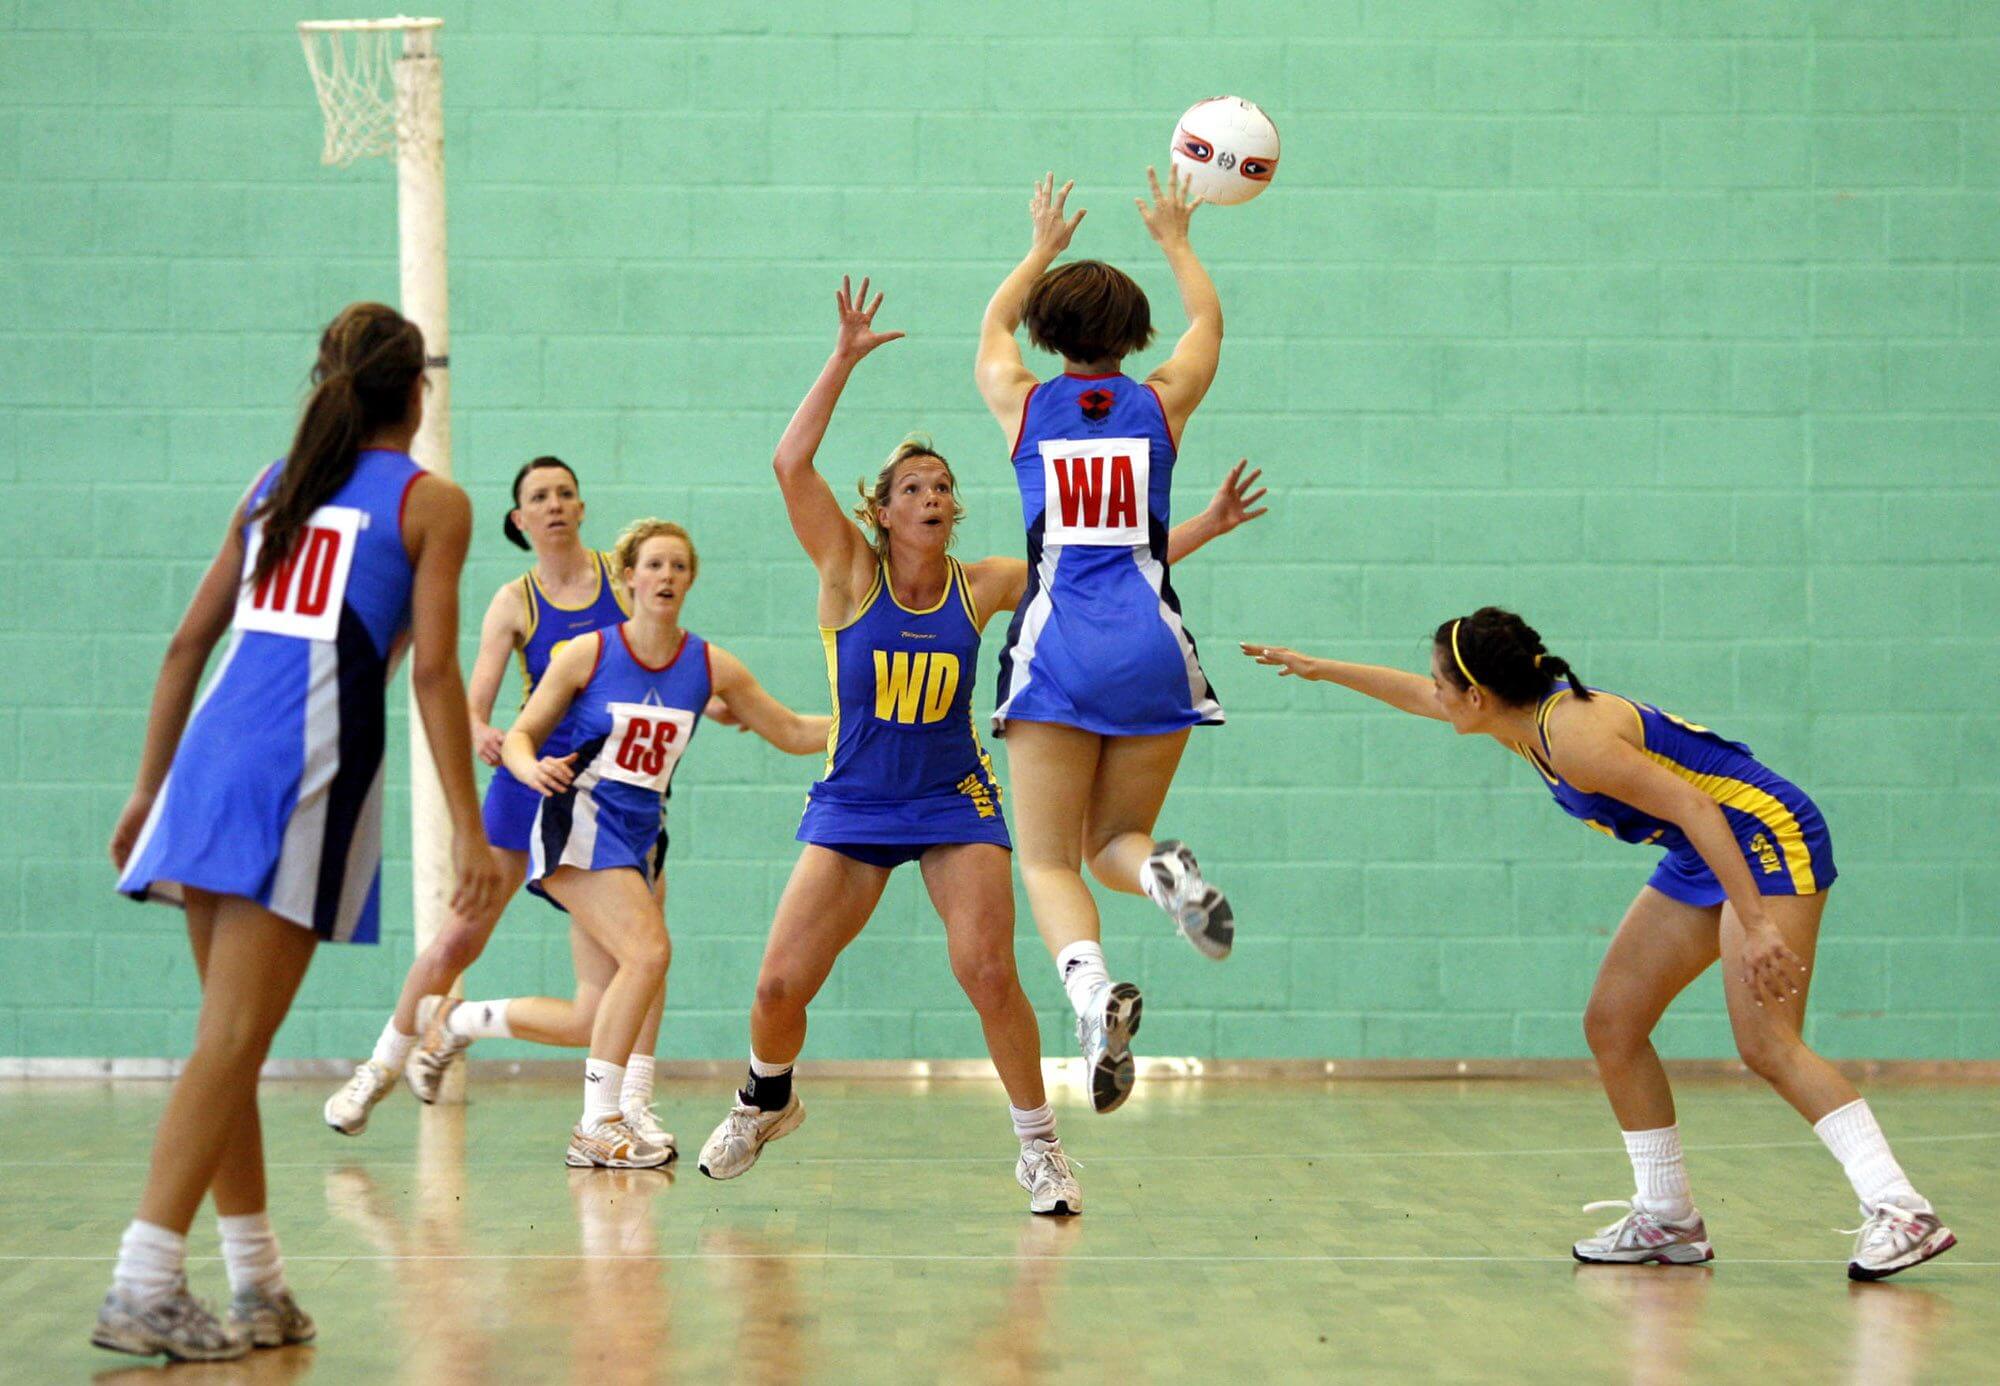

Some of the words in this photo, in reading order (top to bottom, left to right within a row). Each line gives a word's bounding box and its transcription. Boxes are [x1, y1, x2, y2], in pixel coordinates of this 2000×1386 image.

[1053, 456, 1138, 528] WA
[873, 650, 960, 725] WD
[615, 717, 678, 776] GS
